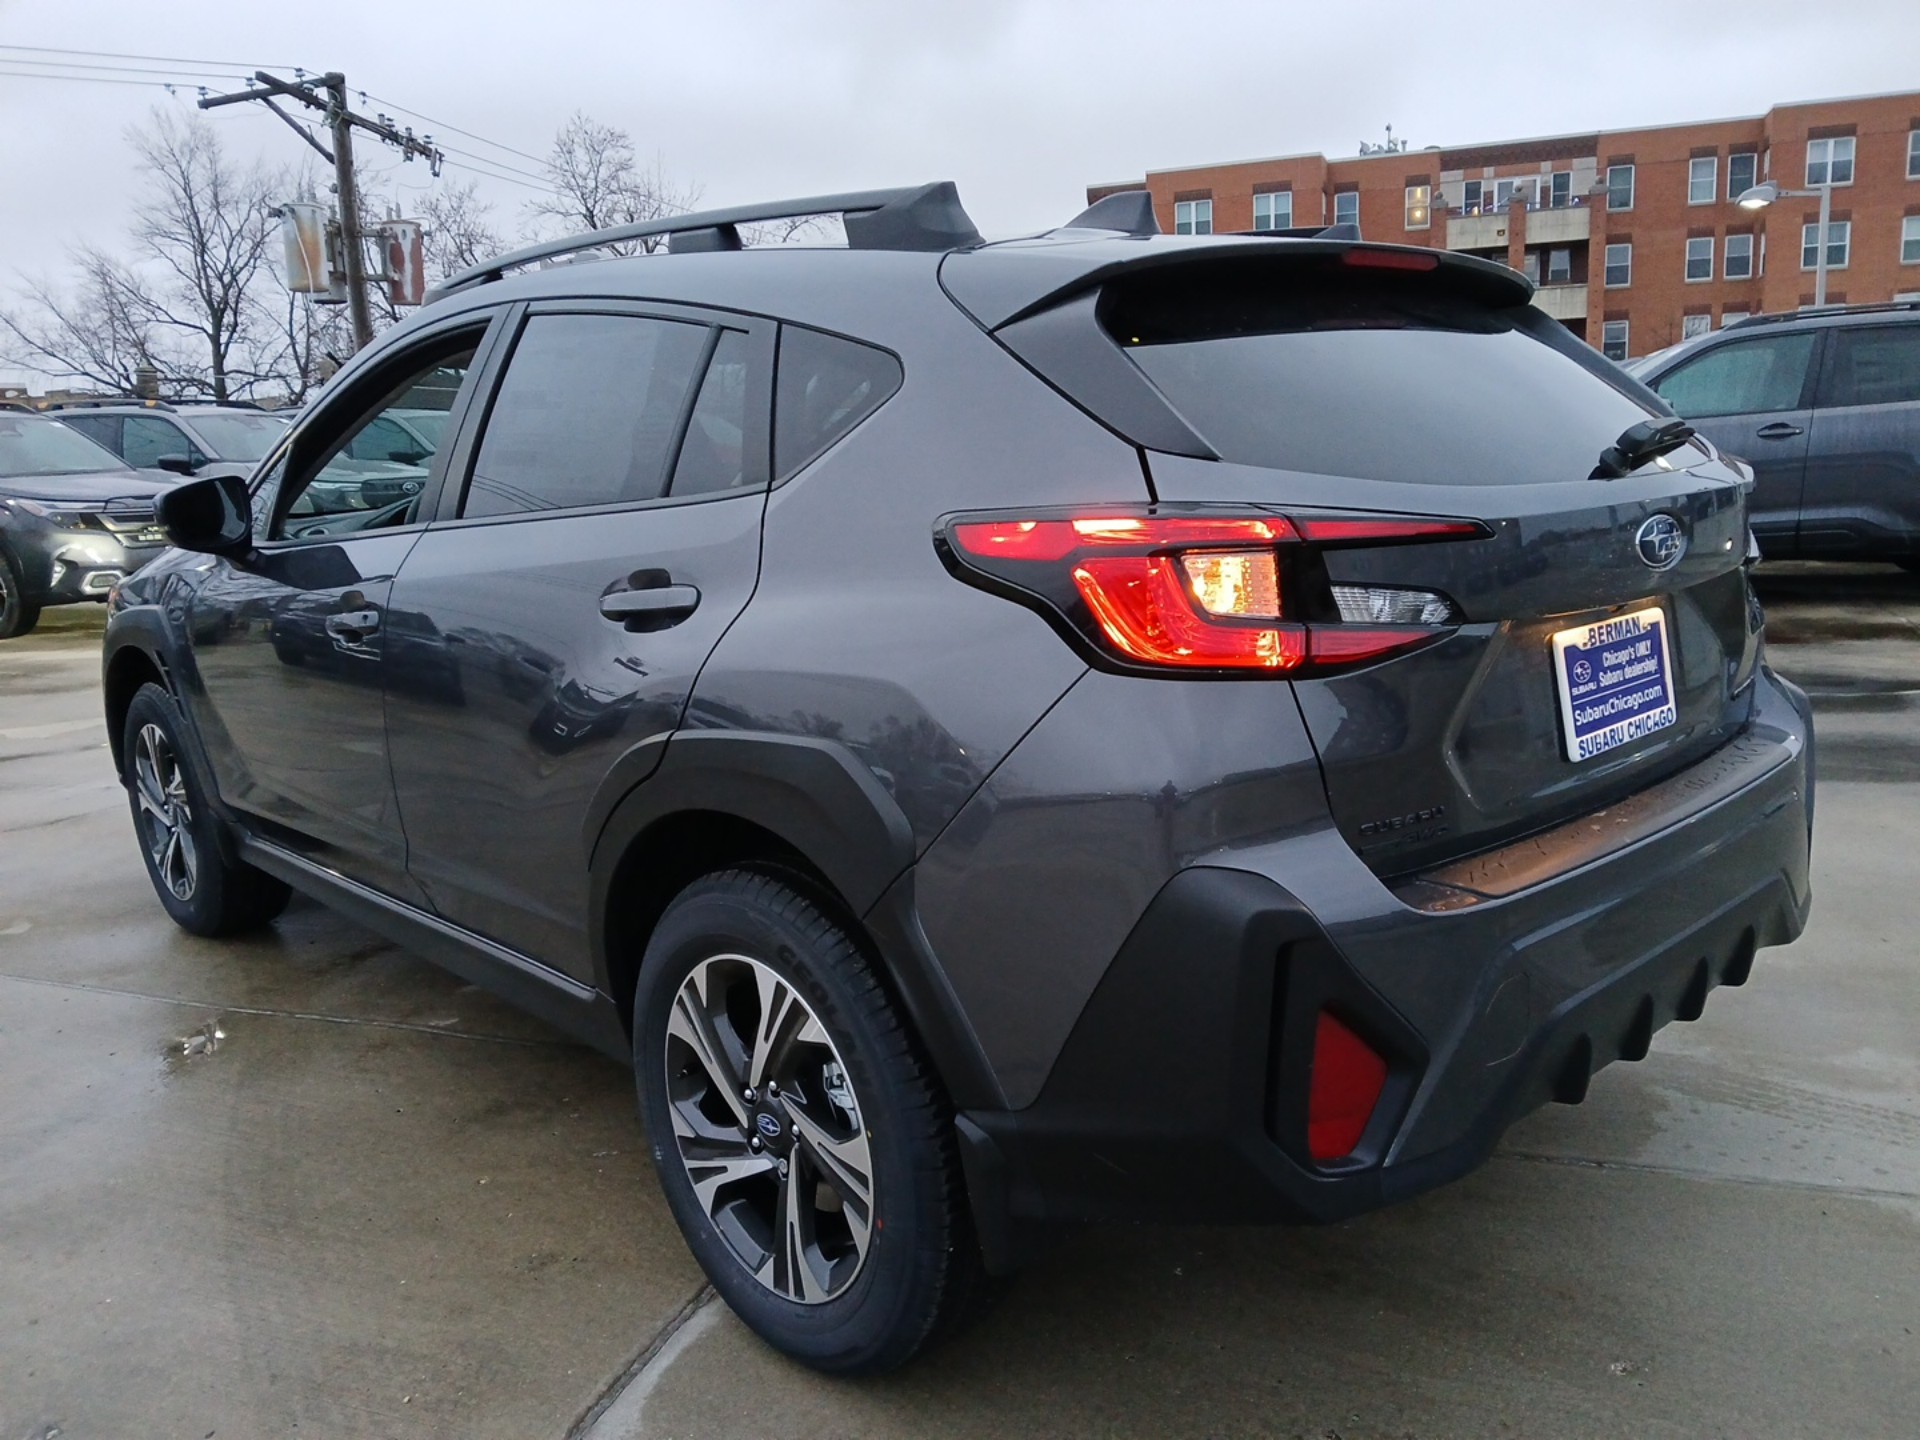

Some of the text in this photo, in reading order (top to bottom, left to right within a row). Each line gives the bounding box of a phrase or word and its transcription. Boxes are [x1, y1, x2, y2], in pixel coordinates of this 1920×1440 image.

[1588, 616, 1641, 648] BERMAN
[1602, 639, 1652, 668] Chicago's ONLY
[1599, 655, 1658, 687] Subaru dealership!
[1571, 682, 1597, 697] SUBARU
[1574, 685, 1662, 726] SubaruChicago.com
[1578, 707, 1674, 758] SUBARU CHICAGO
[1359, 805, 1446, 836] SUBARU
